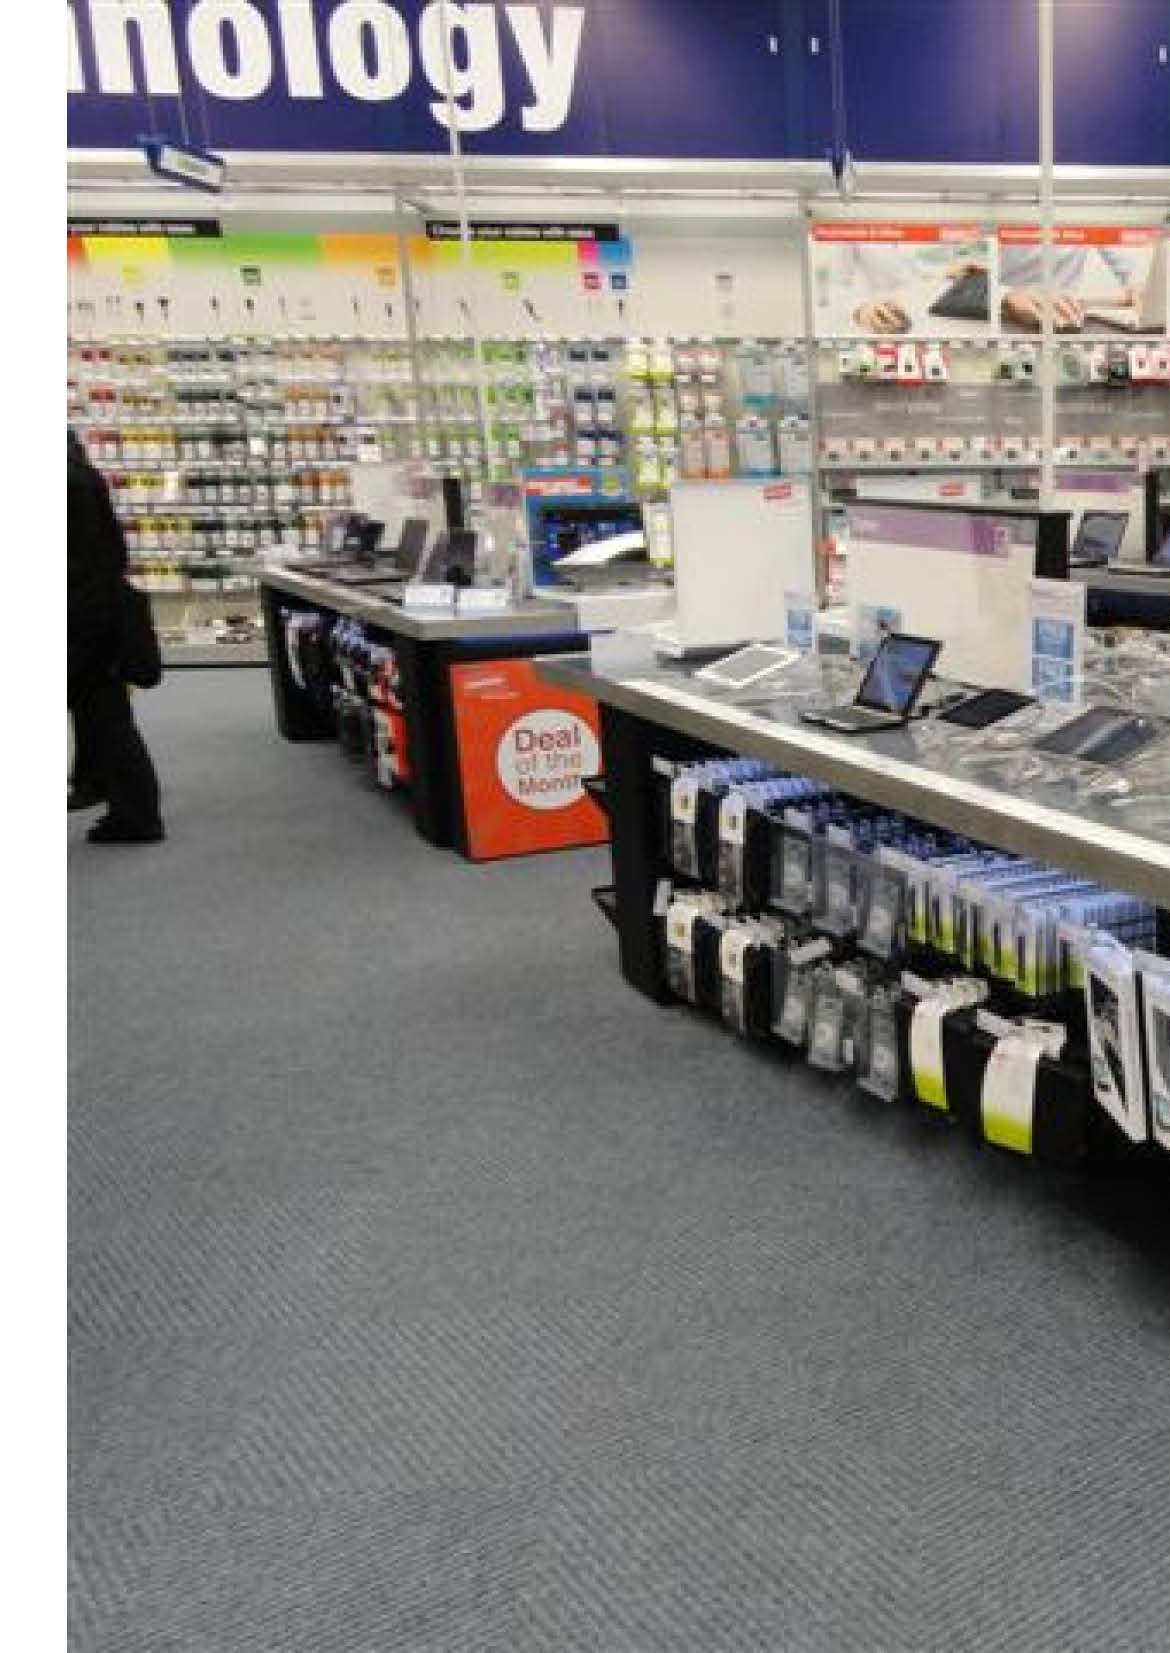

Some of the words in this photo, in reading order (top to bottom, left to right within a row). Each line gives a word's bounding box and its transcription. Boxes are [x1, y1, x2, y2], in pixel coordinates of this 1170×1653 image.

[67, 0, 585, 131] nology
[515, 722, 582, 752] Deal
[516, 753, 537, 774] of
[544, 751, 582, 774] the
